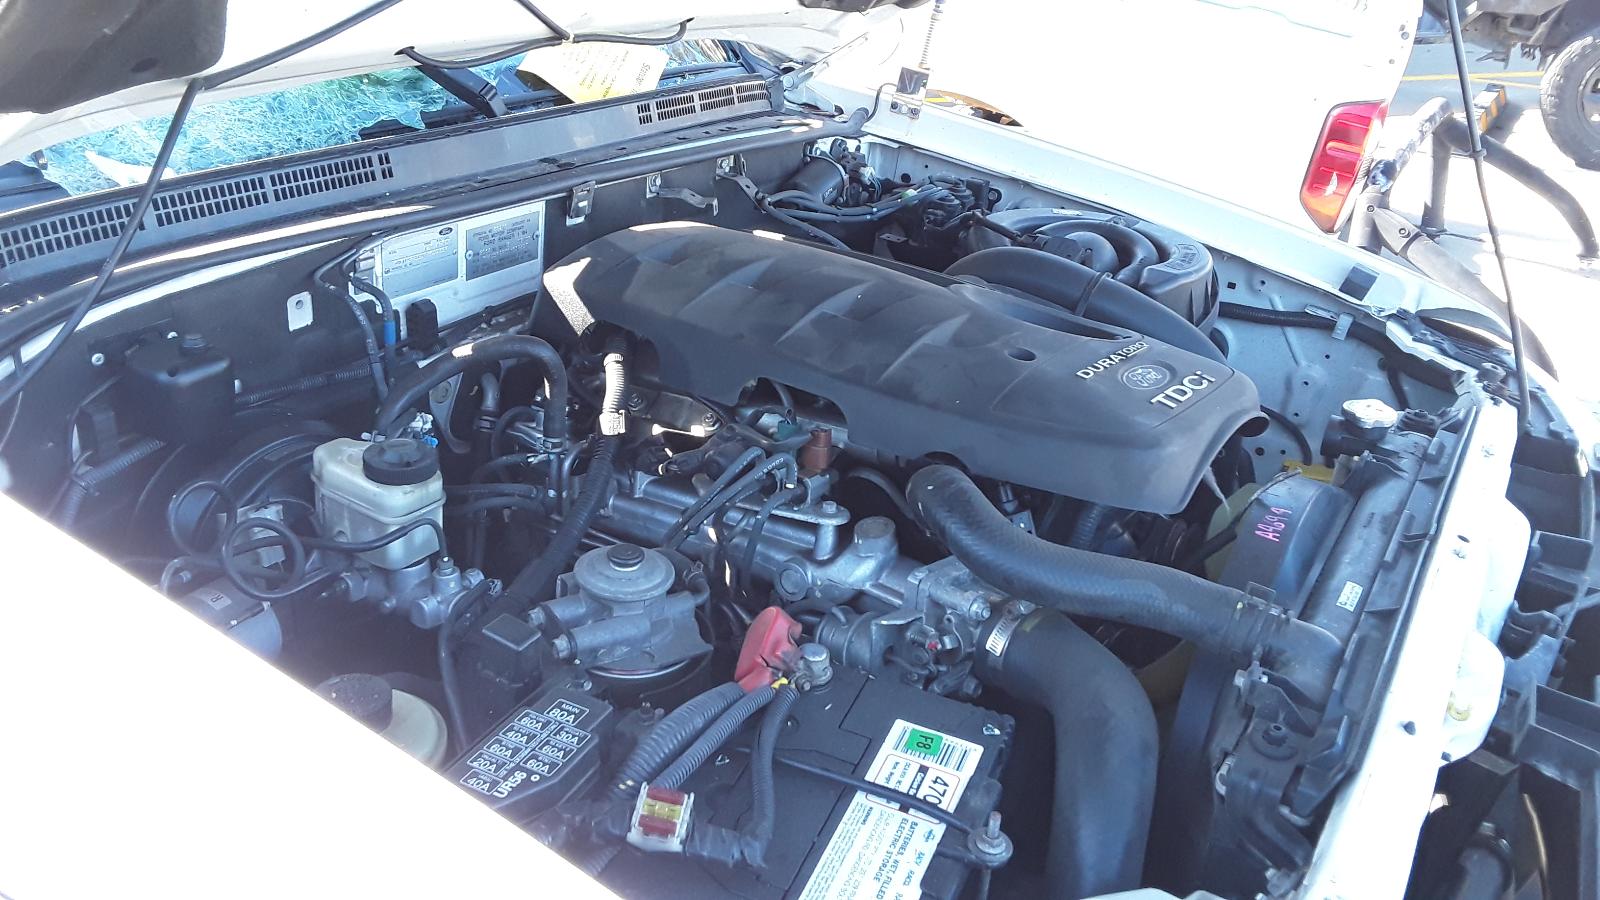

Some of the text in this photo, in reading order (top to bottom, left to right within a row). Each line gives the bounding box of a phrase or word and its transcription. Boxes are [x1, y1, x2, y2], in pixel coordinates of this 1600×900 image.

[1076, 341, 1150, 380] DURATORQ
[1127, 366, 1164, 388] Ford
[1150, 370, 1217, 409] TDCi
[561, 702, 581, 714] MAIN
[520, 716, 543, 732] 60A
[549, 708, 576, 725] 80A
[506, 730, 528, 745] 40A
[556, 731, 580, 745] 30A
[916, 734, 934, 750] F8
[489, 743, 513, 758] 60A
[542, 745, 565, 760] 60A
[472, 757, 497, 773] 20A
[526, 759, 550, 774] 60A
[467, 777, 491, 793] 40A
[493, 770, 527, 798] UR56
[923, 776, 950, 805] 470
[889, 817, 909, 850] ELECTRIC
[873, 850, 895, 882] STORAGE
